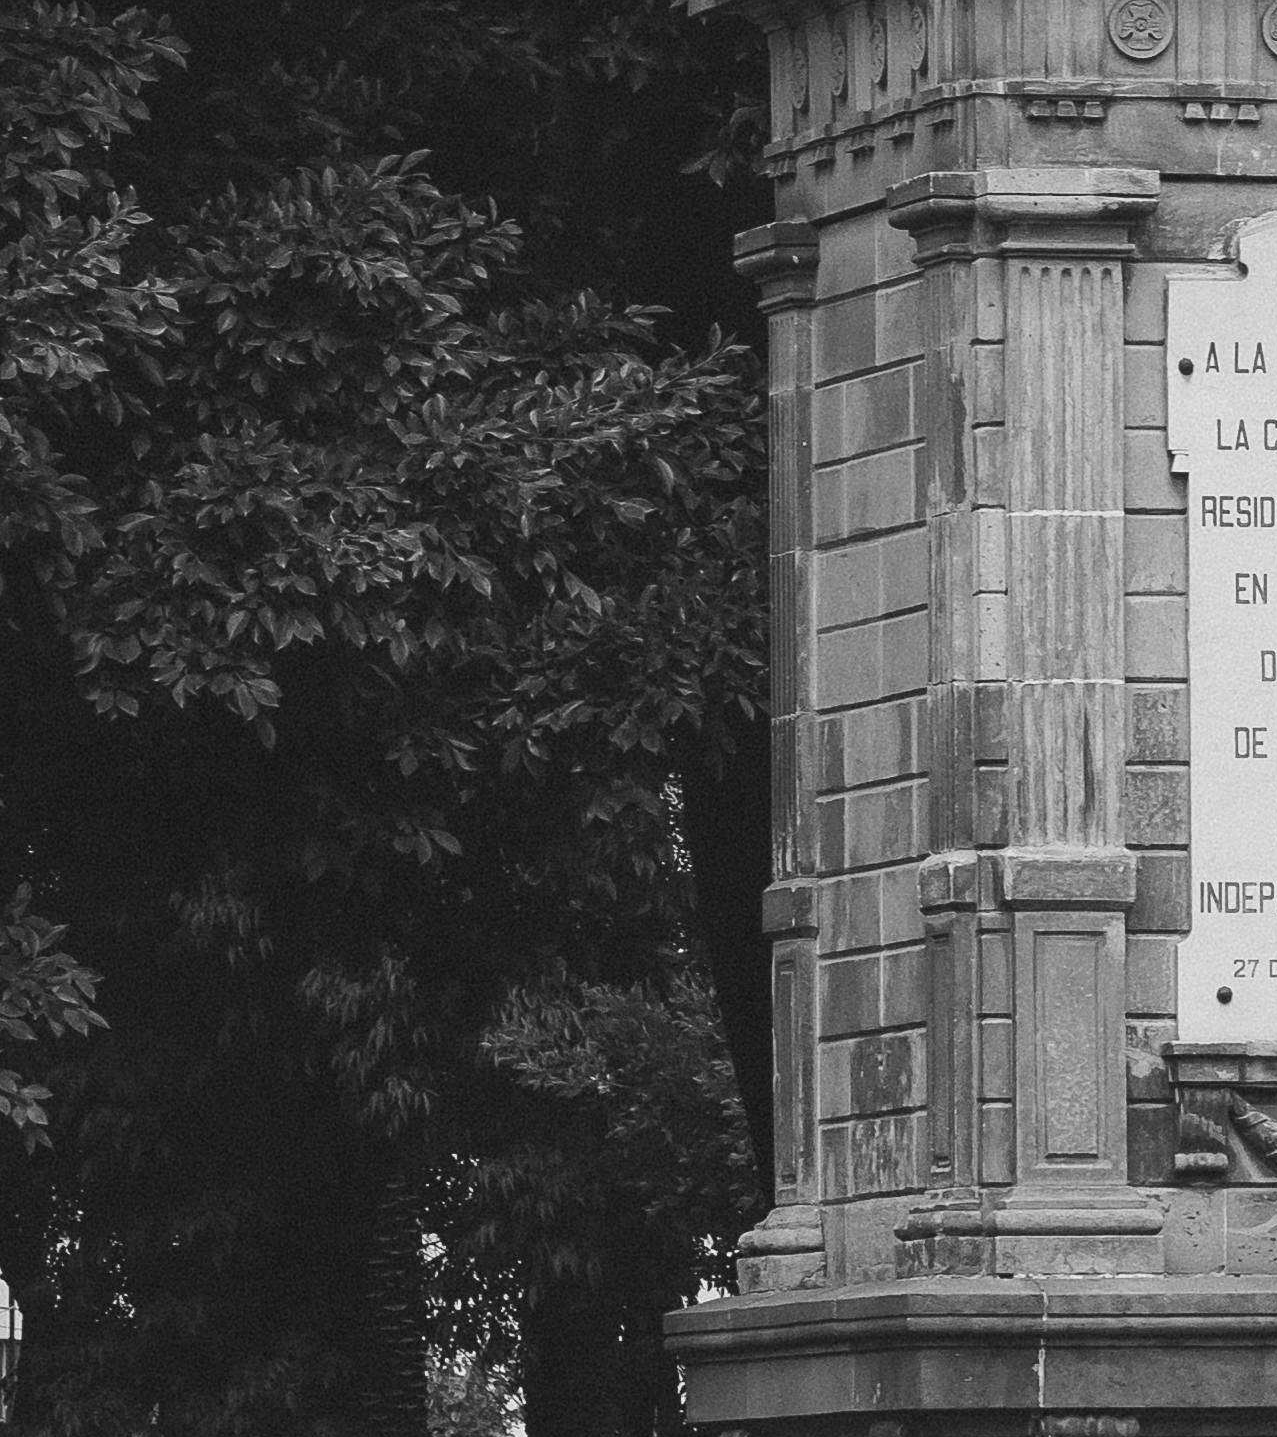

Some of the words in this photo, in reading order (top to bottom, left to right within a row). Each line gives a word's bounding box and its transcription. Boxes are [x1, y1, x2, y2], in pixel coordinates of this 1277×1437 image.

[1206, 342, 1219, 372] A
[1235, 342, 1266, 373] LA
[1217, 419, 1249, 450] LA
[1236, 573, 1267, 604] EN
[1235, 727, 1267, 758] DE
[1234, 960, 1259, 977] 27
